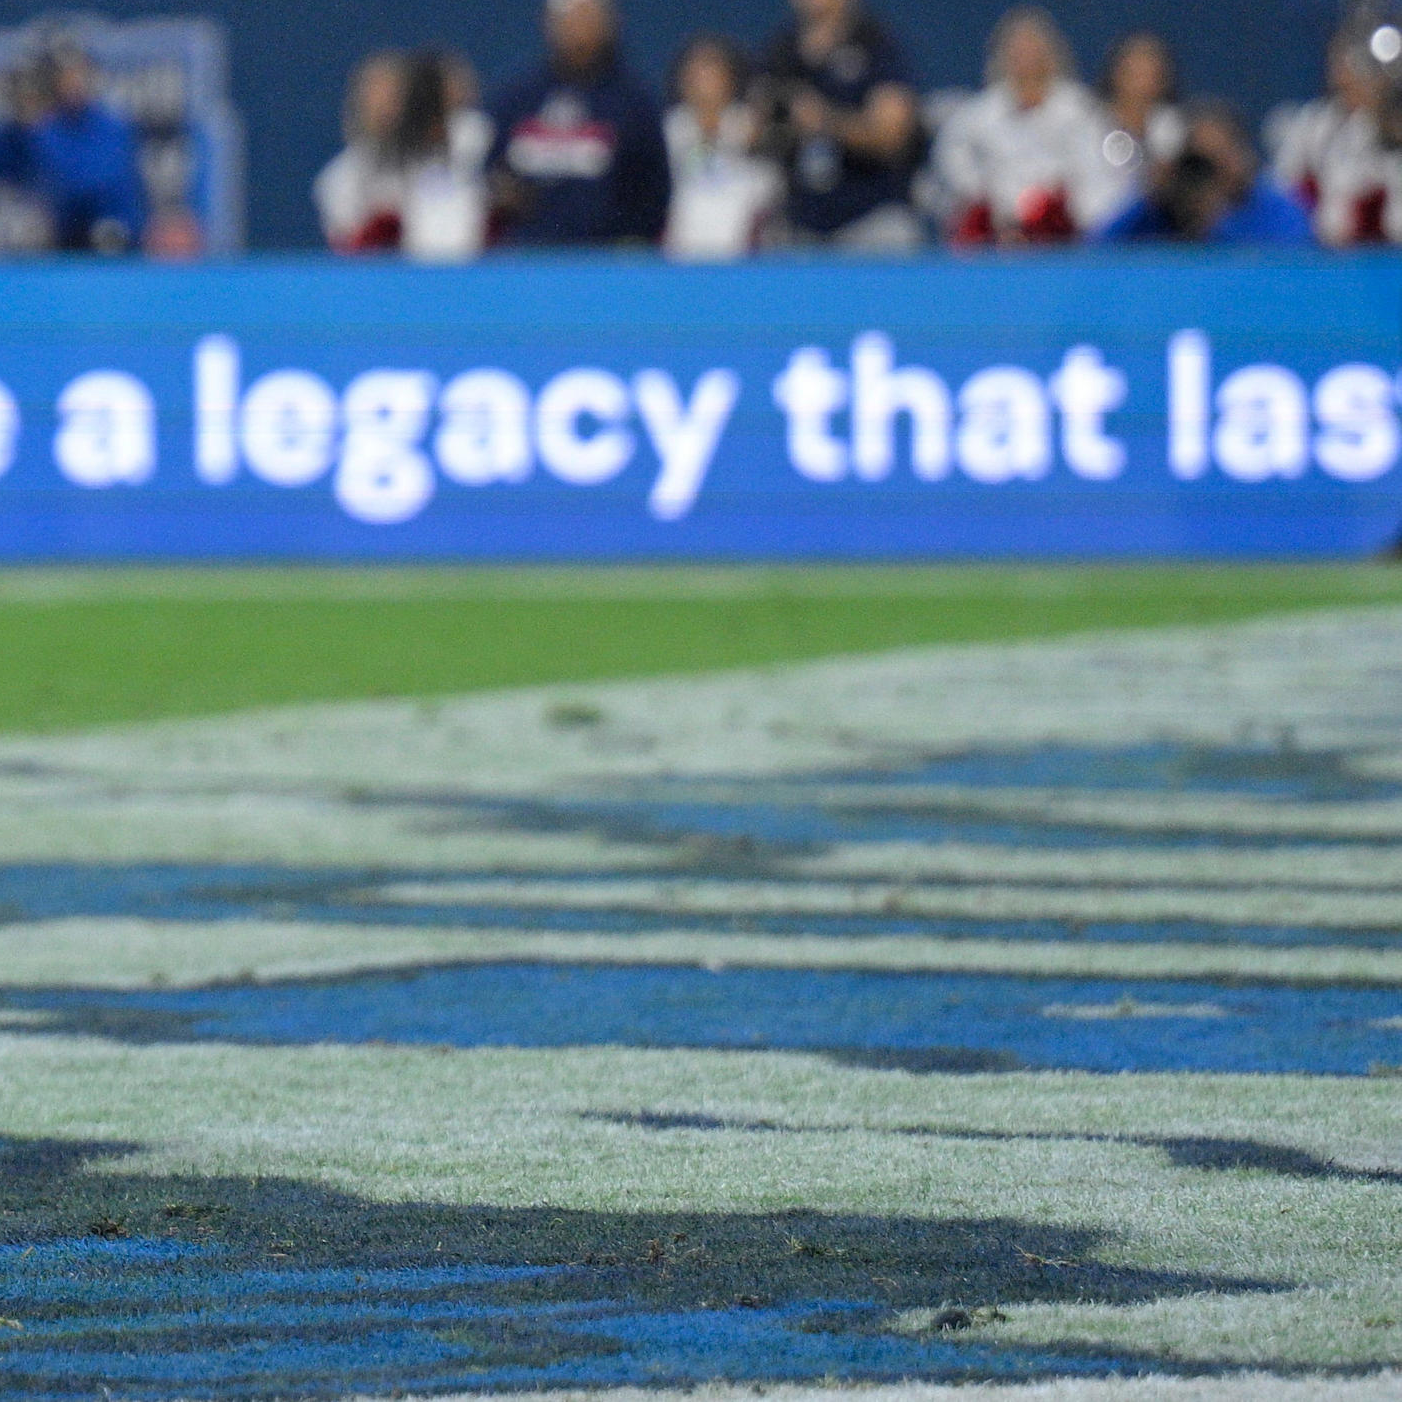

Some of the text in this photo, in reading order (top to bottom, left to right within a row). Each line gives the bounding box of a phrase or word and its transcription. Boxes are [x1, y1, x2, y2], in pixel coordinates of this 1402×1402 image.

[52, 368, 157, 490] a
[194, 332, 741, 525] legacy
[772, 328, 1128, 485] that
[1165, 327, 1402, 484] las
